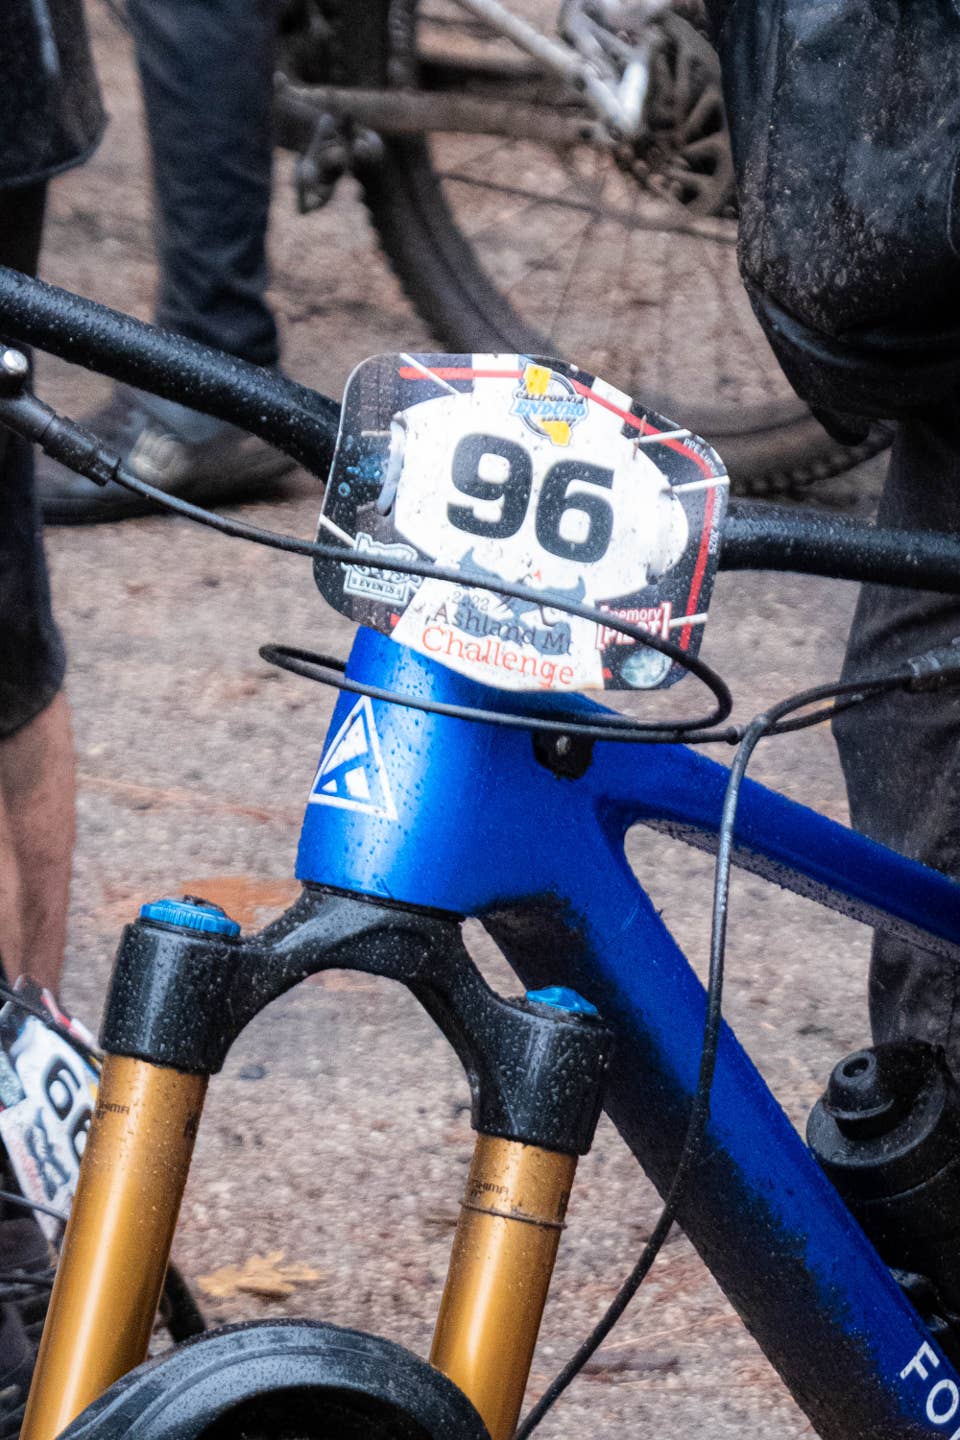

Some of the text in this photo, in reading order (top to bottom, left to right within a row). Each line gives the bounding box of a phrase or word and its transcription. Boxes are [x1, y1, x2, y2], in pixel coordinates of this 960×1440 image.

[515, 400, 585, 418] ENDURO
[446, 432, 615, 563] 96
[432, 602, 537, 648] Ashland
[605, 606, 665, 622] emory
[421, 625, 575, 690] Challenge
